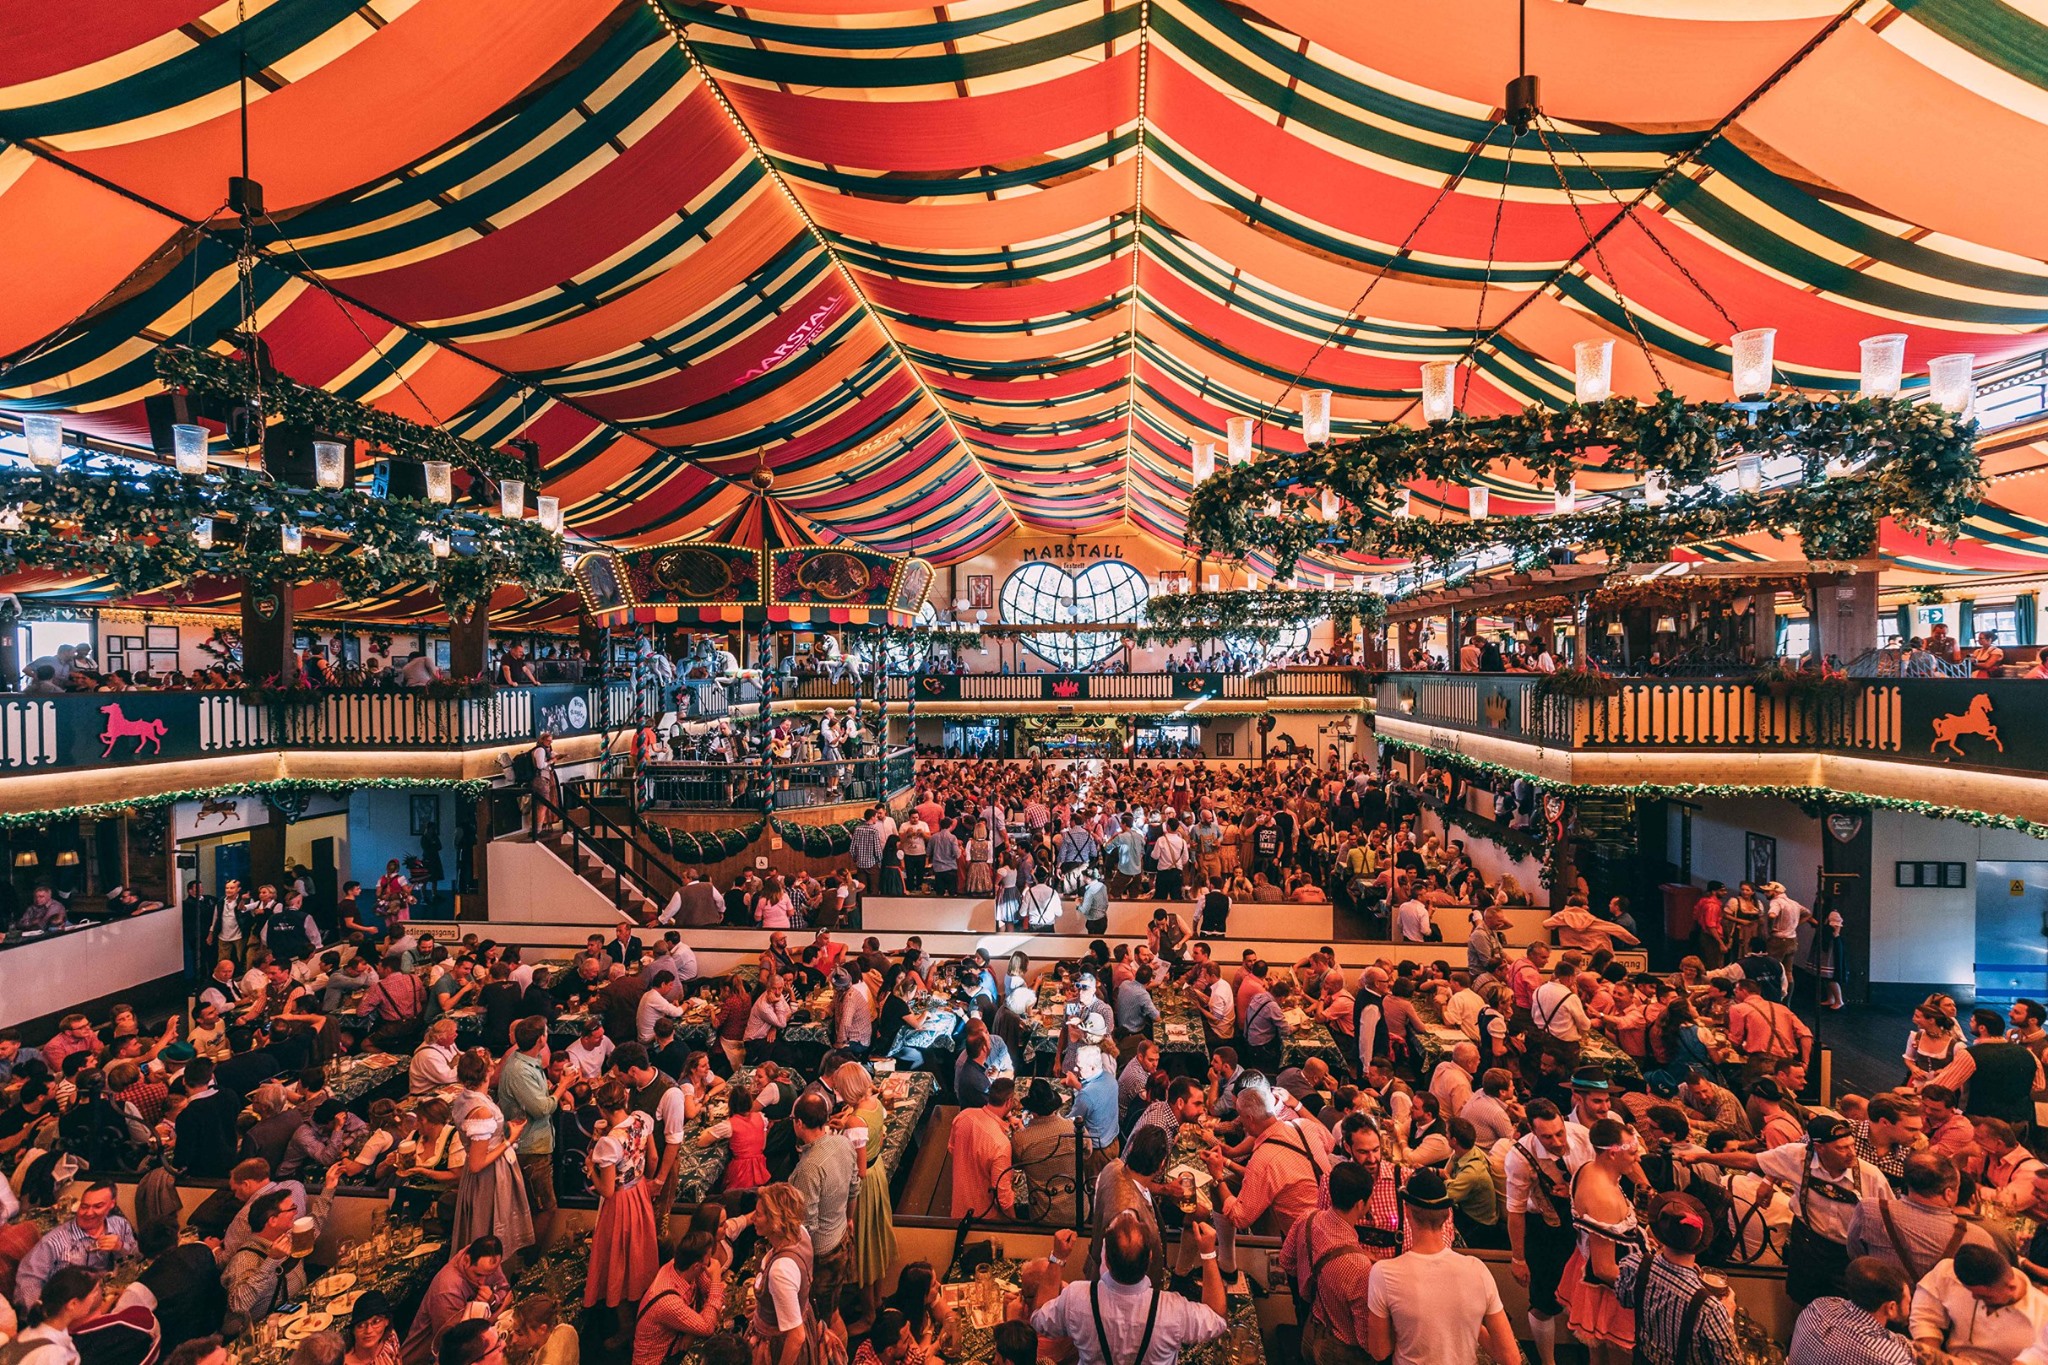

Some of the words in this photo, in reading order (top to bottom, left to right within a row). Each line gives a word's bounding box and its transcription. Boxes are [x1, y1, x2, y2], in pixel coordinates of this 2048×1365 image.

[1023, 543, 1123, 561] MARSTALL
[1455, 734, 1461, 752] 2
[1834, 883, 1840, 894] E
[406, 928, 455, 937] edienungsgang
